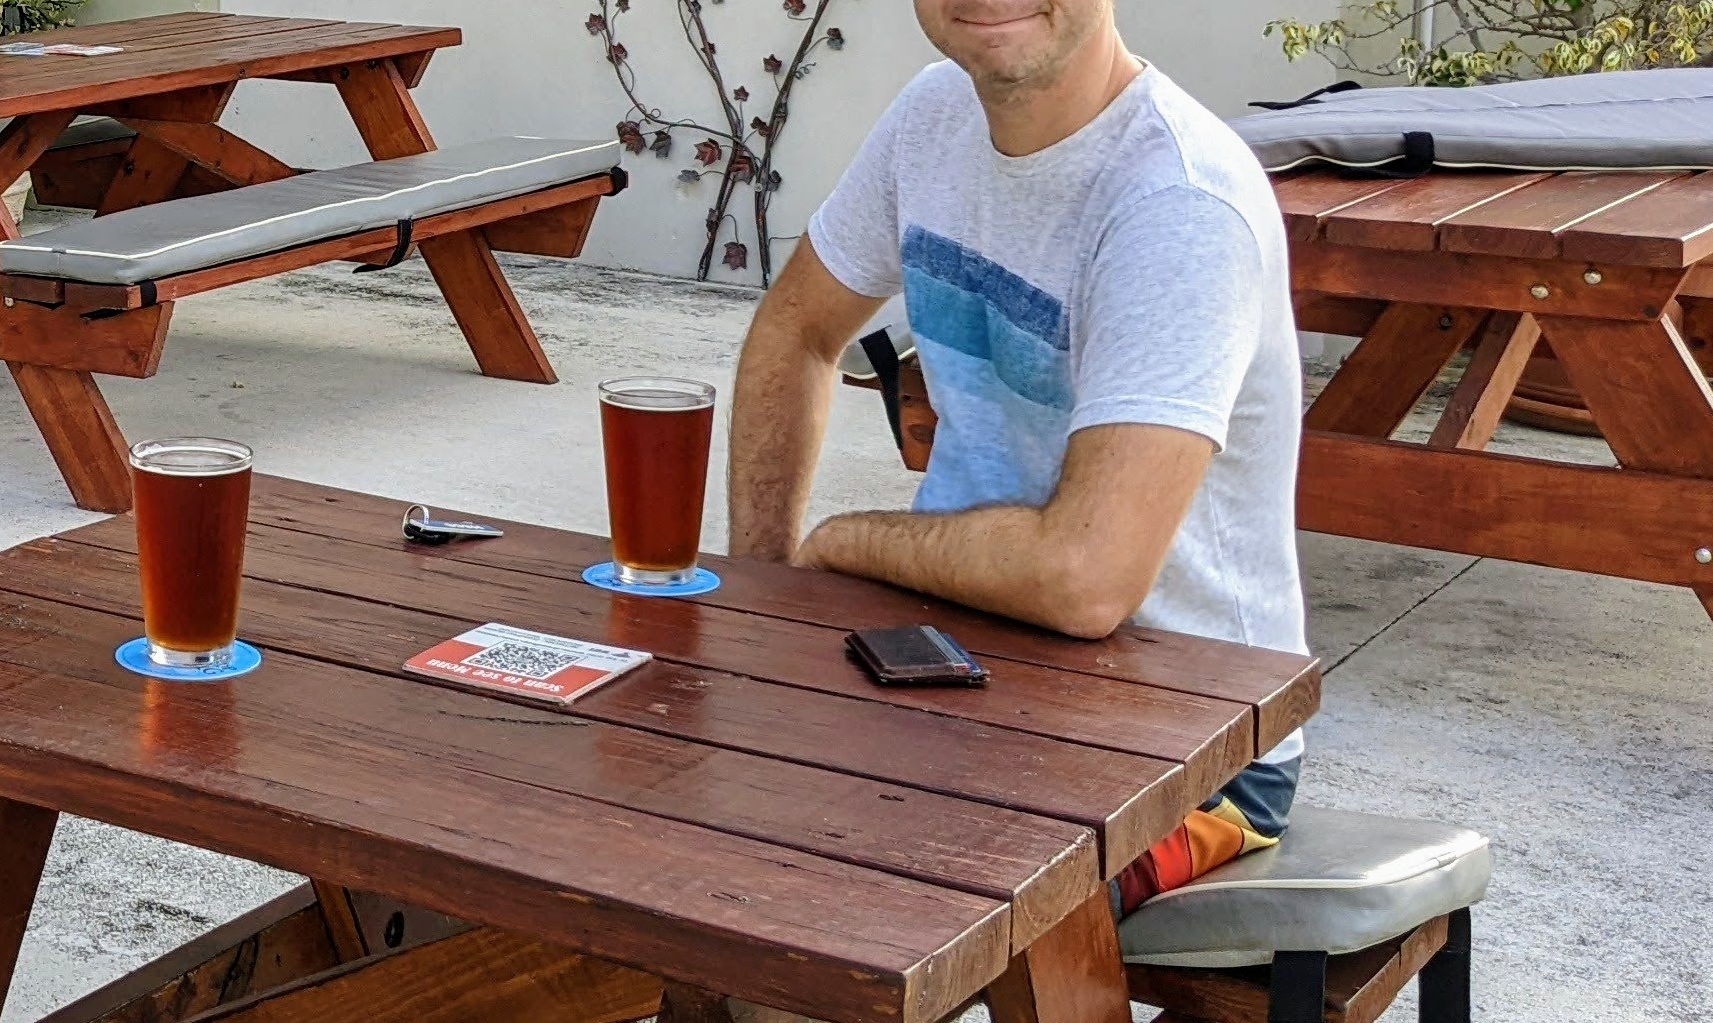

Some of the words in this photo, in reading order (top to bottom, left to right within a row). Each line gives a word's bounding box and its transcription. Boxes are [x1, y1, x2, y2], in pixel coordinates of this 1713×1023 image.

[425, 658, 472, 675] Menu
[471, 669, 503, 680] see
[502, 675, 523, 685] to
[522, 679, 565, 693] Scan
